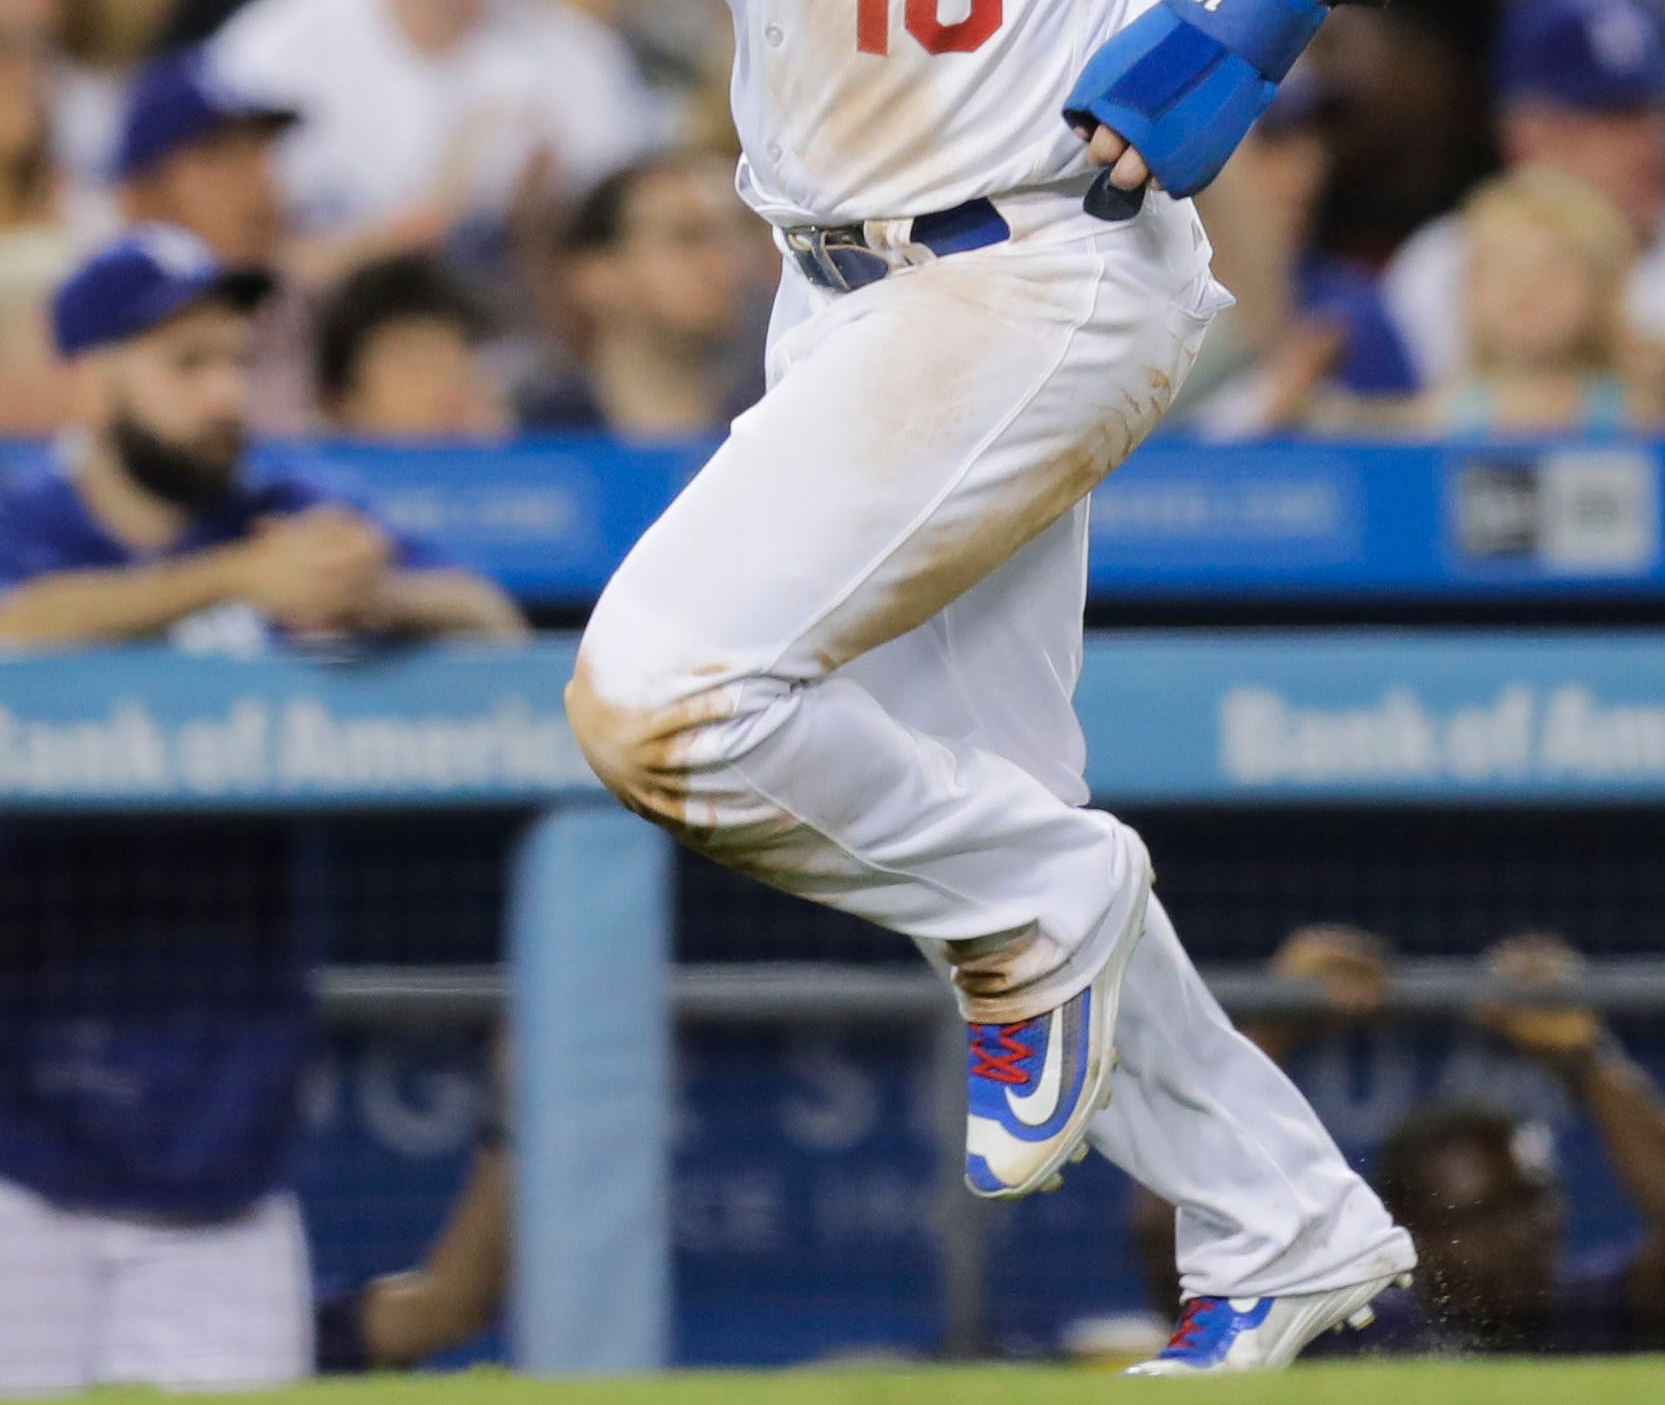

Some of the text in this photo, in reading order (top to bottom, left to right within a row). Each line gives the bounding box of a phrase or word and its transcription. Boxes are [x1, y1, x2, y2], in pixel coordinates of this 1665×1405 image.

[180, 698, 268, 797] of
[278, 695, 592, 795] Americ
[1221, 684, 1436, 785] Bank
[1446, 680, 1533, 780] of
